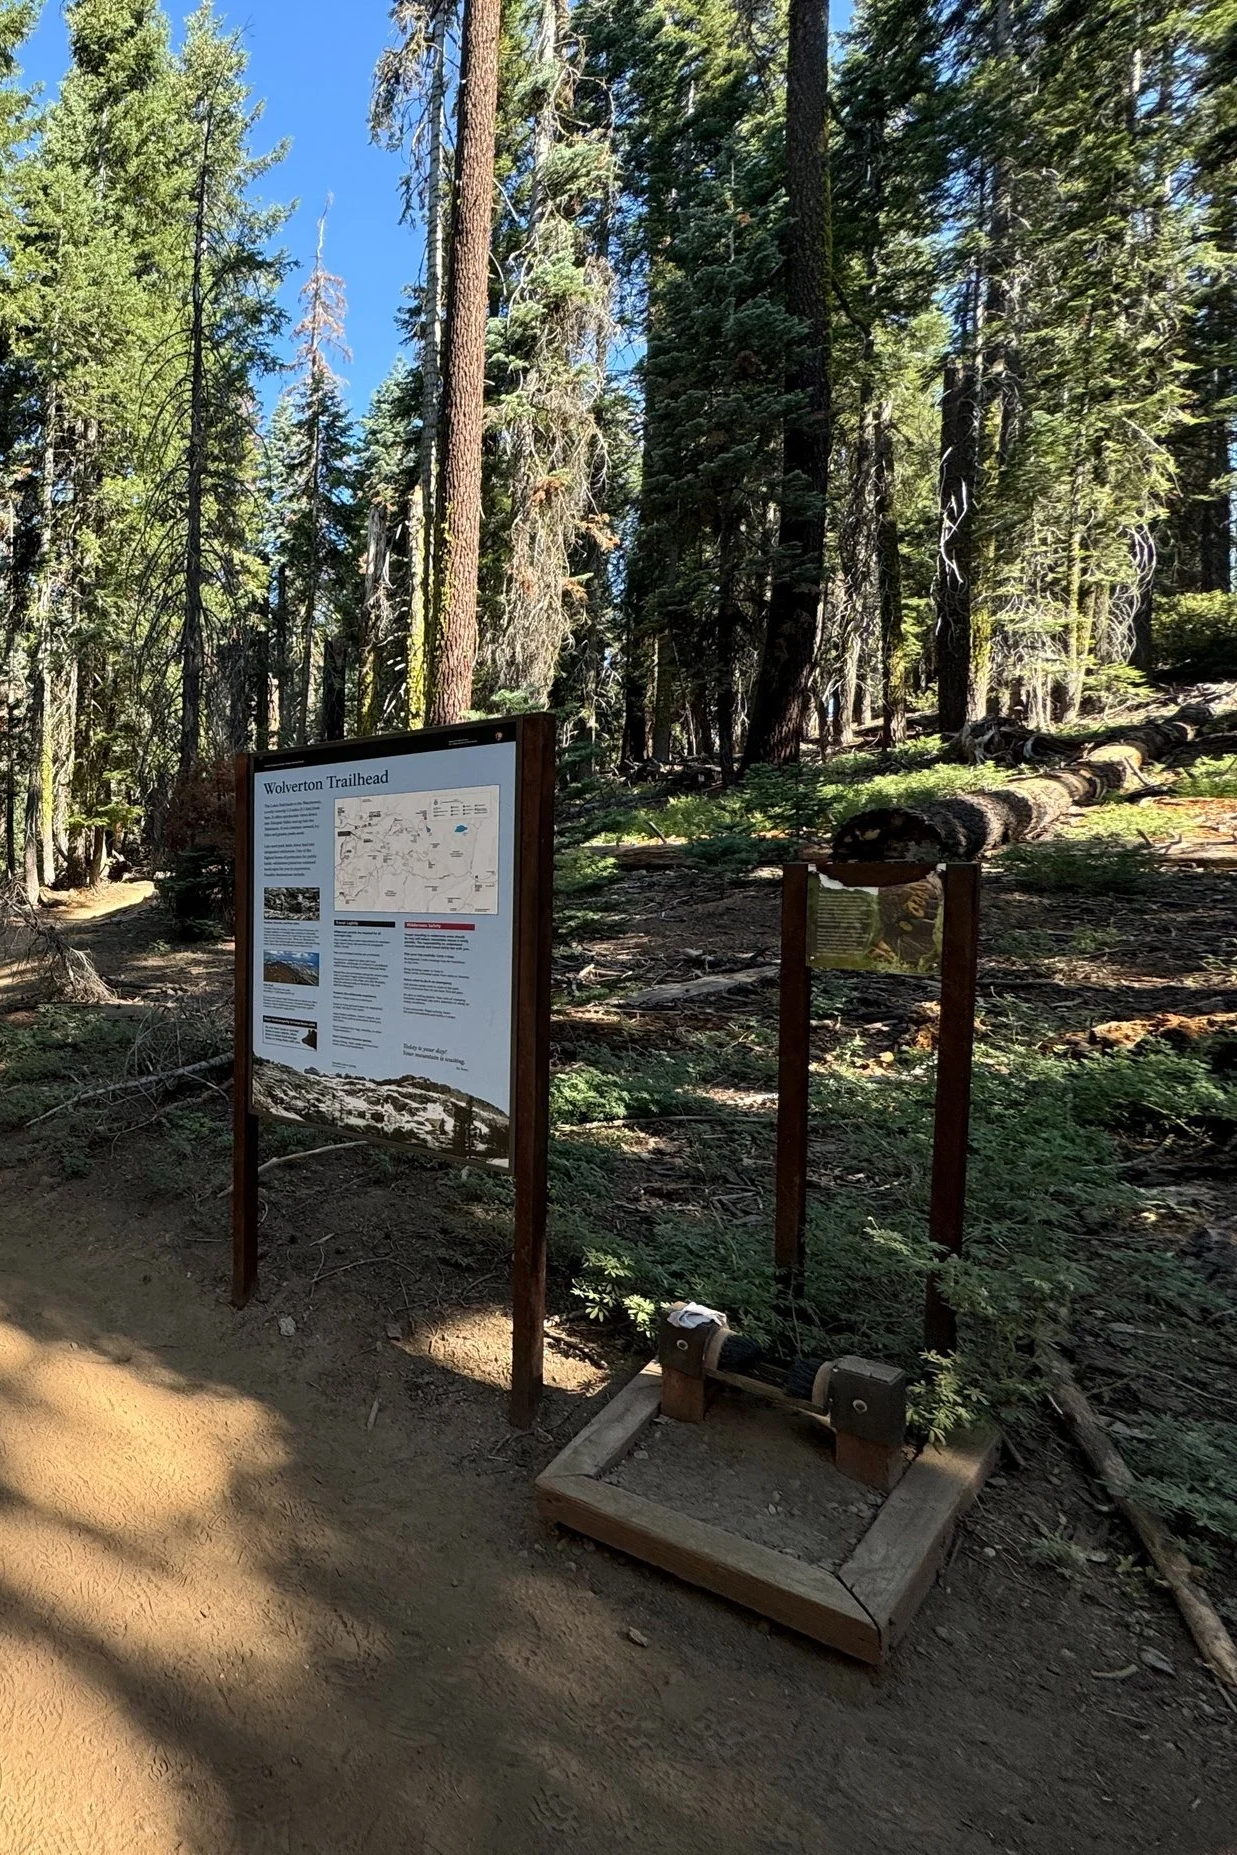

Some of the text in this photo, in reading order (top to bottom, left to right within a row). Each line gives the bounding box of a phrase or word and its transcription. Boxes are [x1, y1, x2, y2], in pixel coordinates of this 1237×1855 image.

[264, 770, 389, 795] Wolverton Trailhead
[403, 1043, 417, 1051] Today
[435, 1047, 447, 1055] day!
[415, 1052, 439, 1060] mountain
